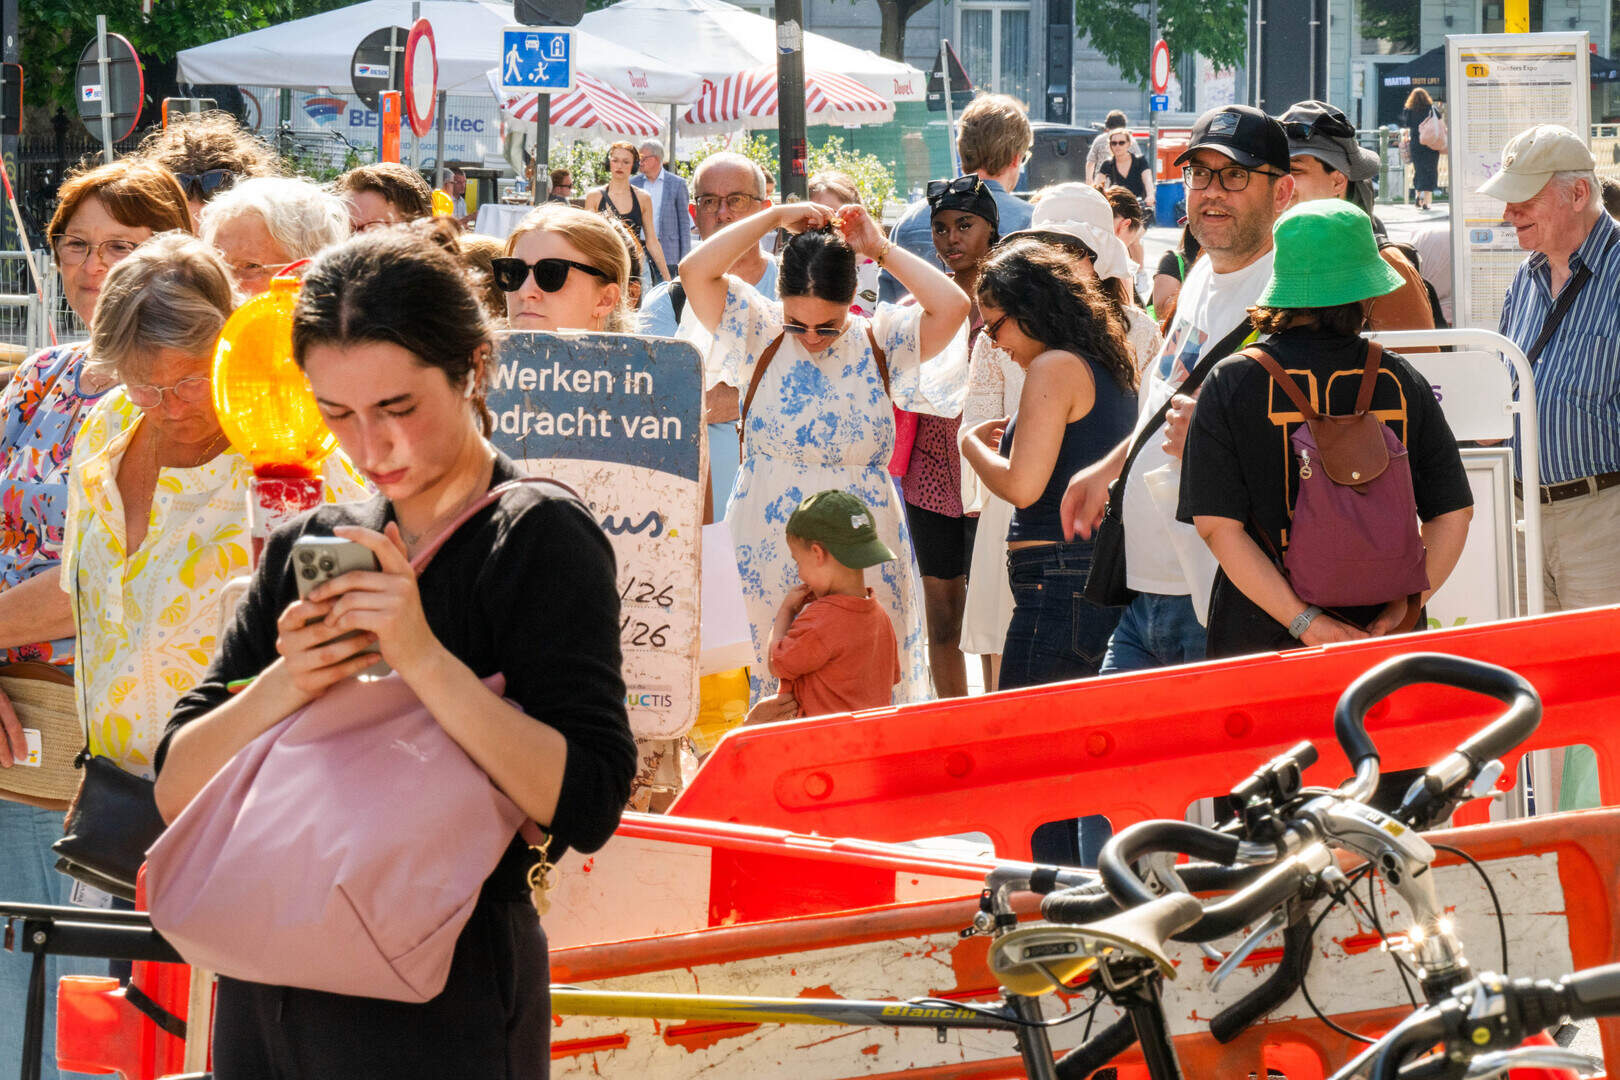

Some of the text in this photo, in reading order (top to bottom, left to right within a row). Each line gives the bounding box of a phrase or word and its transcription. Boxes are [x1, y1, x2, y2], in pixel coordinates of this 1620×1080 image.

[1472, 66, 1485, 76] T1
[1523, 65, 1538, 73] Expo
[893, 78, 914, 95] Duvel
[493, 360, 653, 395] Werken in
[620, 414, 682, 440] van
[624, 694, 672, 708] UCTIS
[881, 1005, 977, 1019] Bianchi
